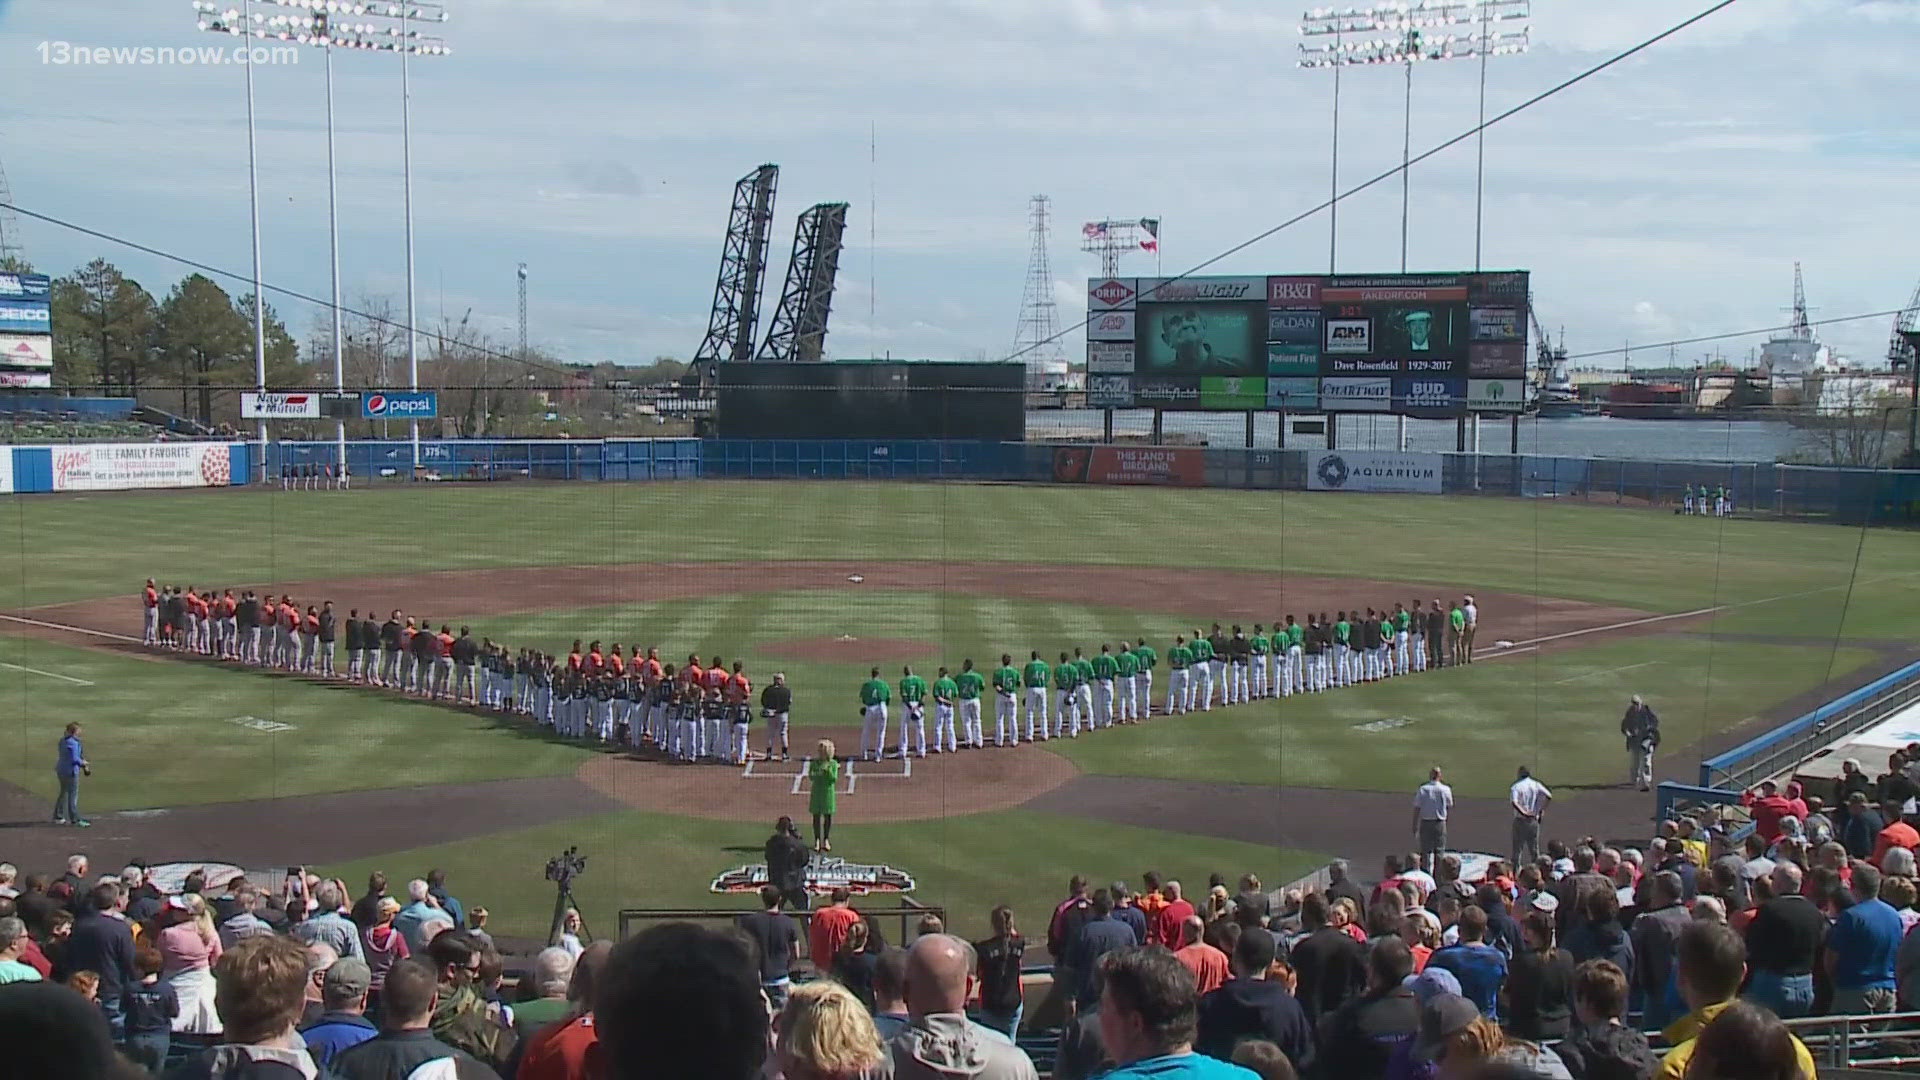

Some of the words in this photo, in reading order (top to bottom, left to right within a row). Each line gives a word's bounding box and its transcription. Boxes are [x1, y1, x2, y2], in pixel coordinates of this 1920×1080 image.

[1340, 279, 1371, 287] NORFOLK
[1372, 278, 1424, 286] INTERNATIONAL
[1096, 288, 1128, 298] ORKIN
[1273, 283, 1315, 299] BB&T
[1100, 316, 1125, 330] ADP
[1271, 317, 1315, 328] GILDAN
[1269, 353, 1298, 363] Patient
[1300, 353, 1316, 363] First
[1334, 360, 1355, 370] Dave
[1356, 360, 1399, 370] Rosenfield
[1408, 360, 1452, 370] 1929-2017
[1412, 382, 1445, 394] BUD
[257, 393, 287, 405] Navy
[266, 403, 308, 414] Mutual
[390, 398, 430, 414] pepsi
[96, 449, 112, 460] THE
[115, 448, 147, 459] FAMILY
[150, 447, 191, 458] FAVORITE
[1117, 450, 1136, 460] THIS
[1139, 451, 1164, 461] LAND
[1167, 452, 1176, 462] IS
[1353, 467, 1433, 479] AQUARIUM
